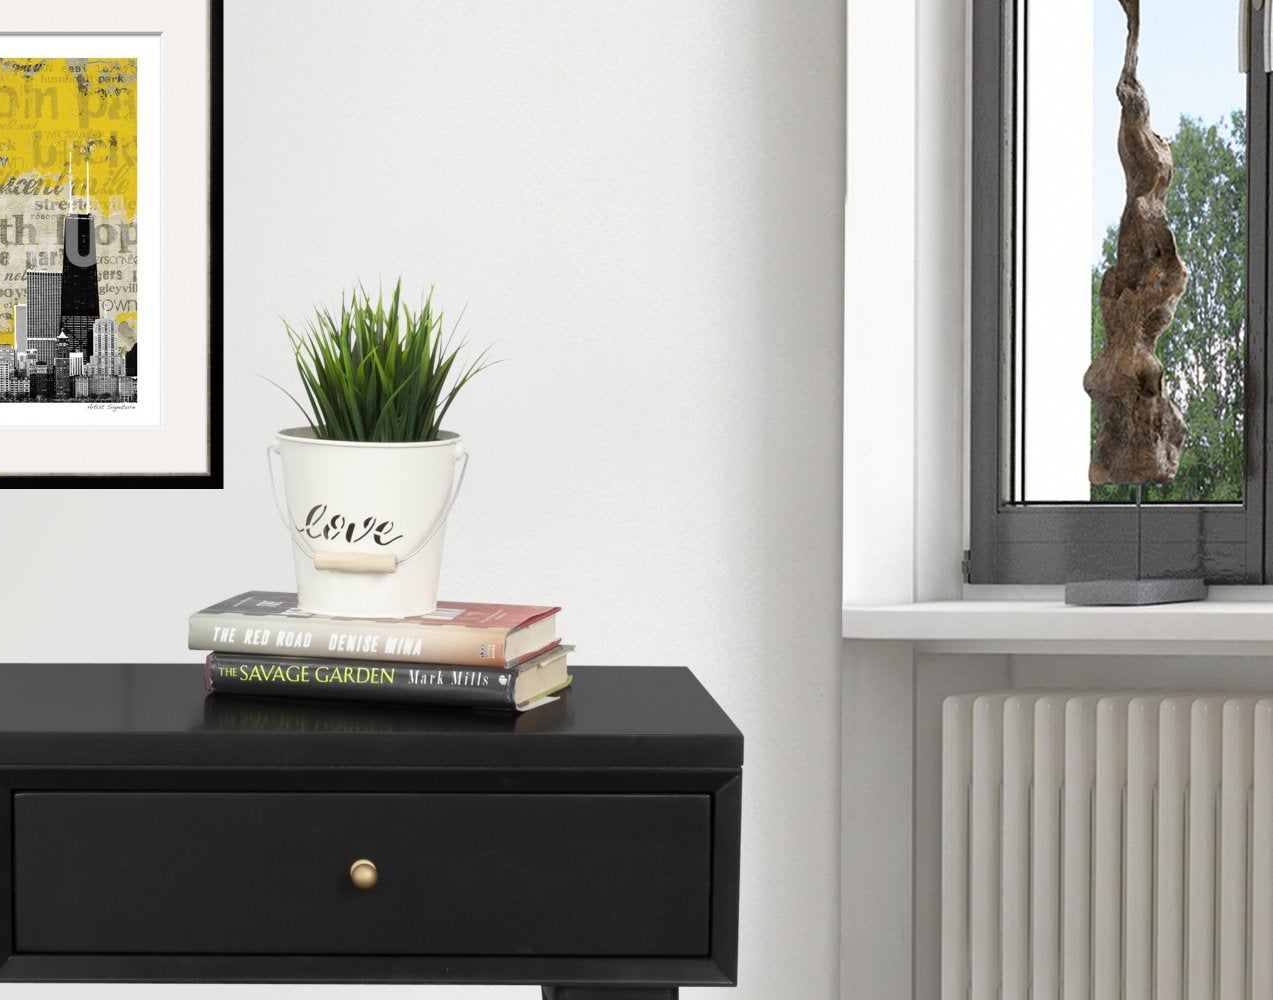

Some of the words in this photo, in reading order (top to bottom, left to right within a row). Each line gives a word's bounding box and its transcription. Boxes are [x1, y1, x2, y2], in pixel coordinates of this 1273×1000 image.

[295, 503, 404, 546] love
[213, 626, 237, 643] THE
[243, 629, 271, 646] RED
[275, 631, 313, 648] ROAD
[328, 633, 379, 653] DENISE
[384, 638, 423, 656] MINA
[218, 666, 238, 677] THE
[239, 664, 311, 684] SAVAGE
[314, 667, 396, 685] GARDEN
[408, 669, 445, 685] Mark
[450, 671, 490, 687] Mills
